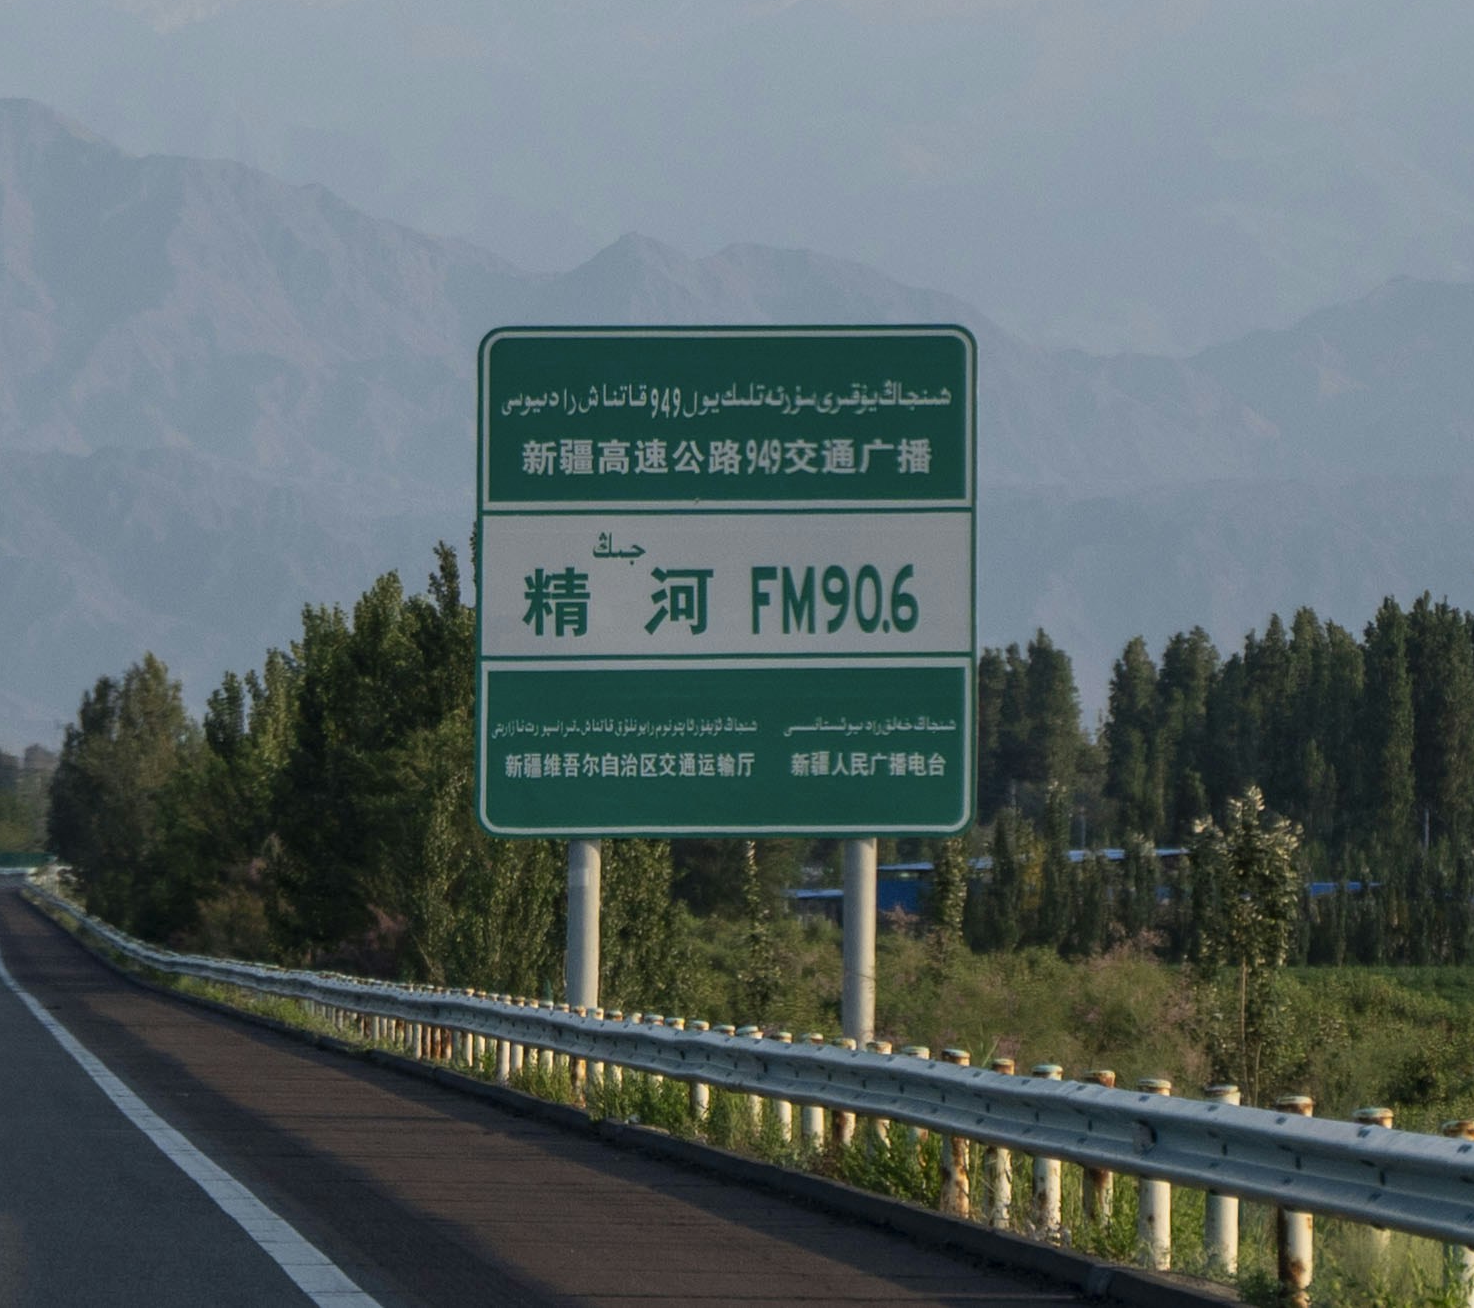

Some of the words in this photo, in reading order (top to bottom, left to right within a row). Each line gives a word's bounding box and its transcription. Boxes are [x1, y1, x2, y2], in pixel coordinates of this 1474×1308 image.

[650, 386, 682, 419] 949
[522, 438, 933, 476] 新疆高速公路949交通广播
[751, 563, 920, 635] FM90.6
[505, 752, 755, 779] 新疆维吾尔自治区交通运输厅
[790, 751, 947, 777] 新疆人民广播电台
